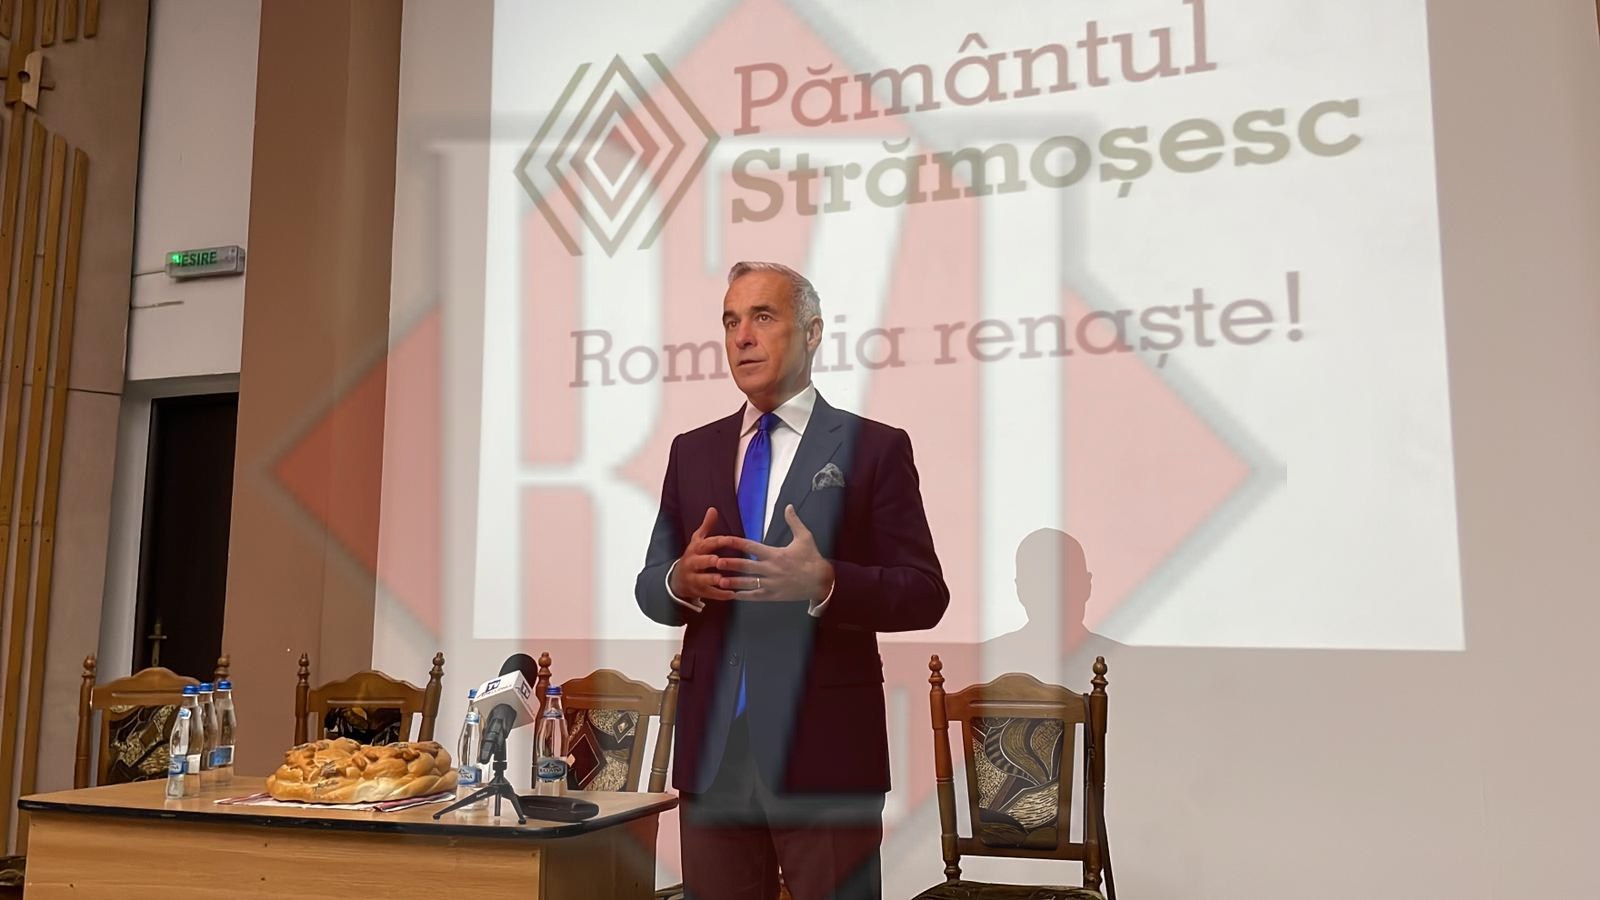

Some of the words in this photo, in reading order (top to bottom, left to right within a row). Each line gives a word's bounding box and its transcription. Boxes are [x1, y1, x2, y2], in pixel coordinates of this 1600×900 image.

[734, 0, 1217, 136] Pământul
[731, 98, 1362, 223] Strămoșesc
[569, 315, 906, 388] Romia
[934, 270, 1304, 368] renaște!
